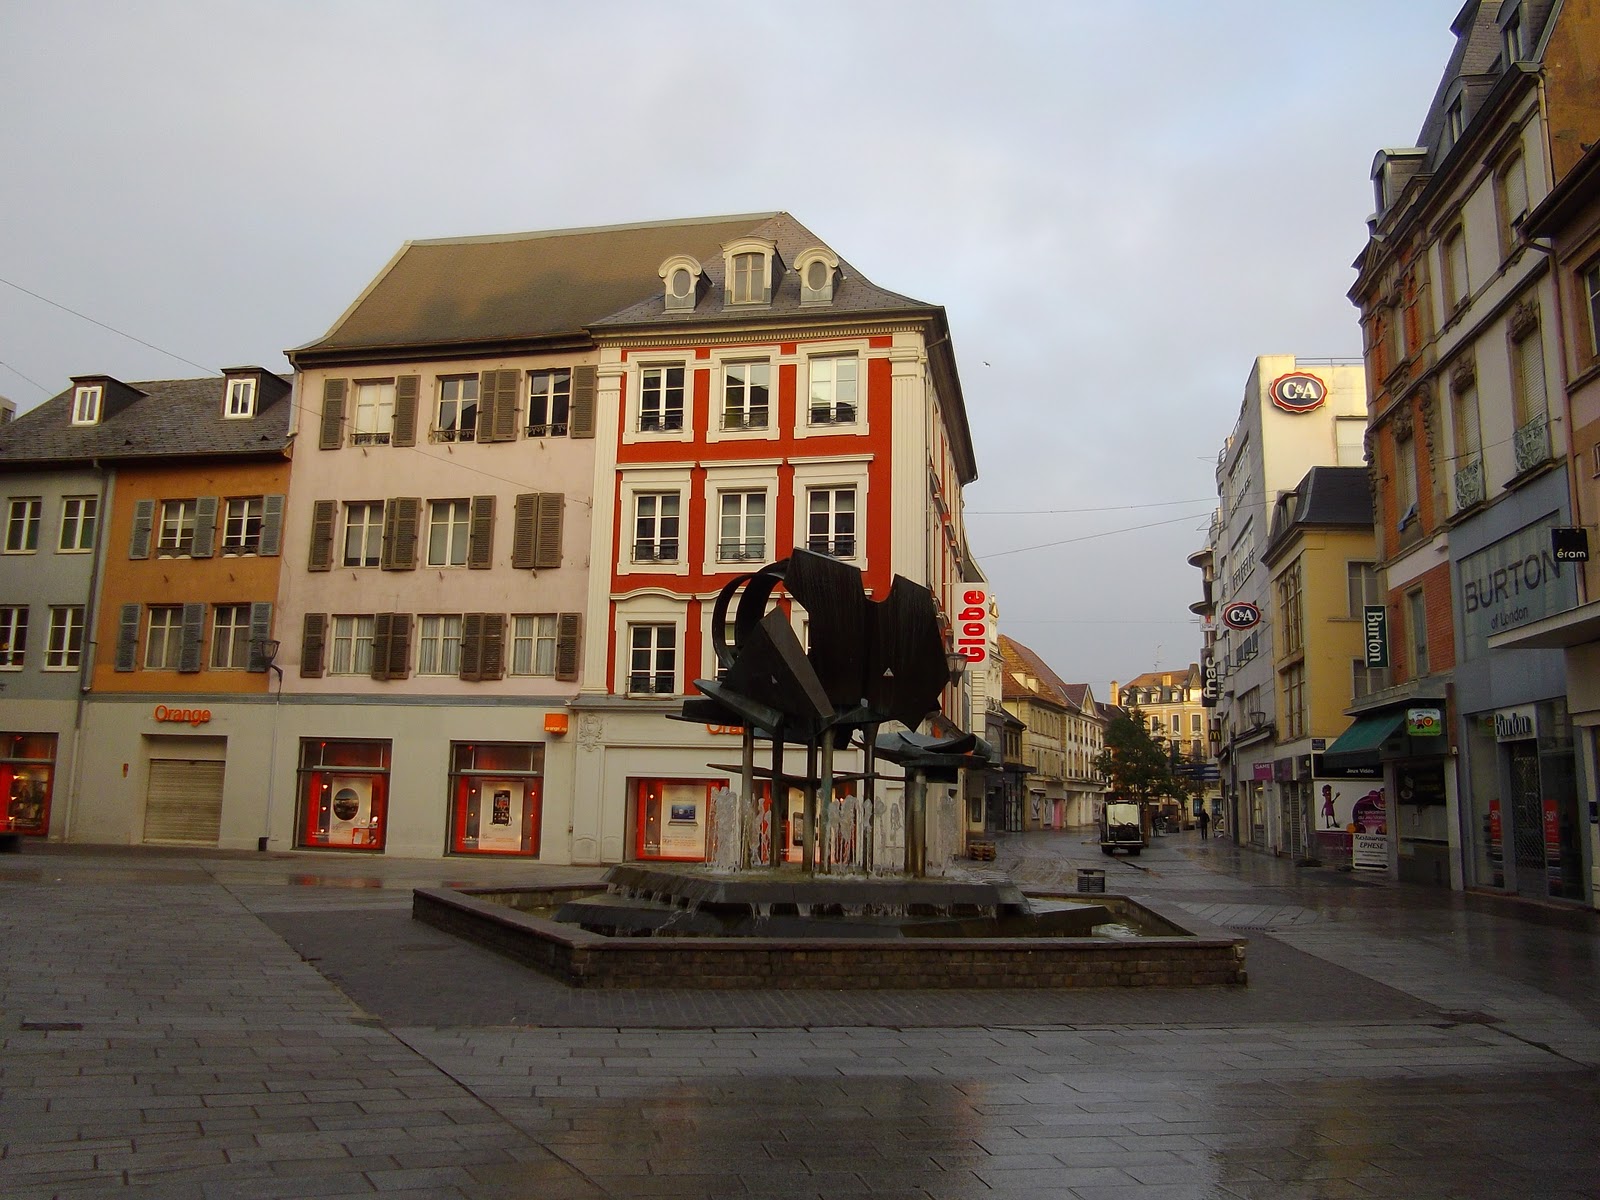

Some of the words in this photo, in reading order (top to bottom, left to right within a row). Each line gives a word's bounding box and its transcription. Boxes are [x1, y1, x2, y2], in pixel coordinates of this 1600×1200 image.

[1282, 381, 1318, 399] C&A
[1556, 548, 1586, 559] éram
[1464, 549, 1560, 614] BURTON
[957, 590, 986, 663] Globe
[1230, 609, 1254, 622] C&A
[1500, 607, 1529, 626] London
[1366, 611, 1384, 662] Burton
[1203, 656, 1217, 699] fnac
[154, 704, 212, 728] Orange
[1495, 713, 1531, 738] Burton
